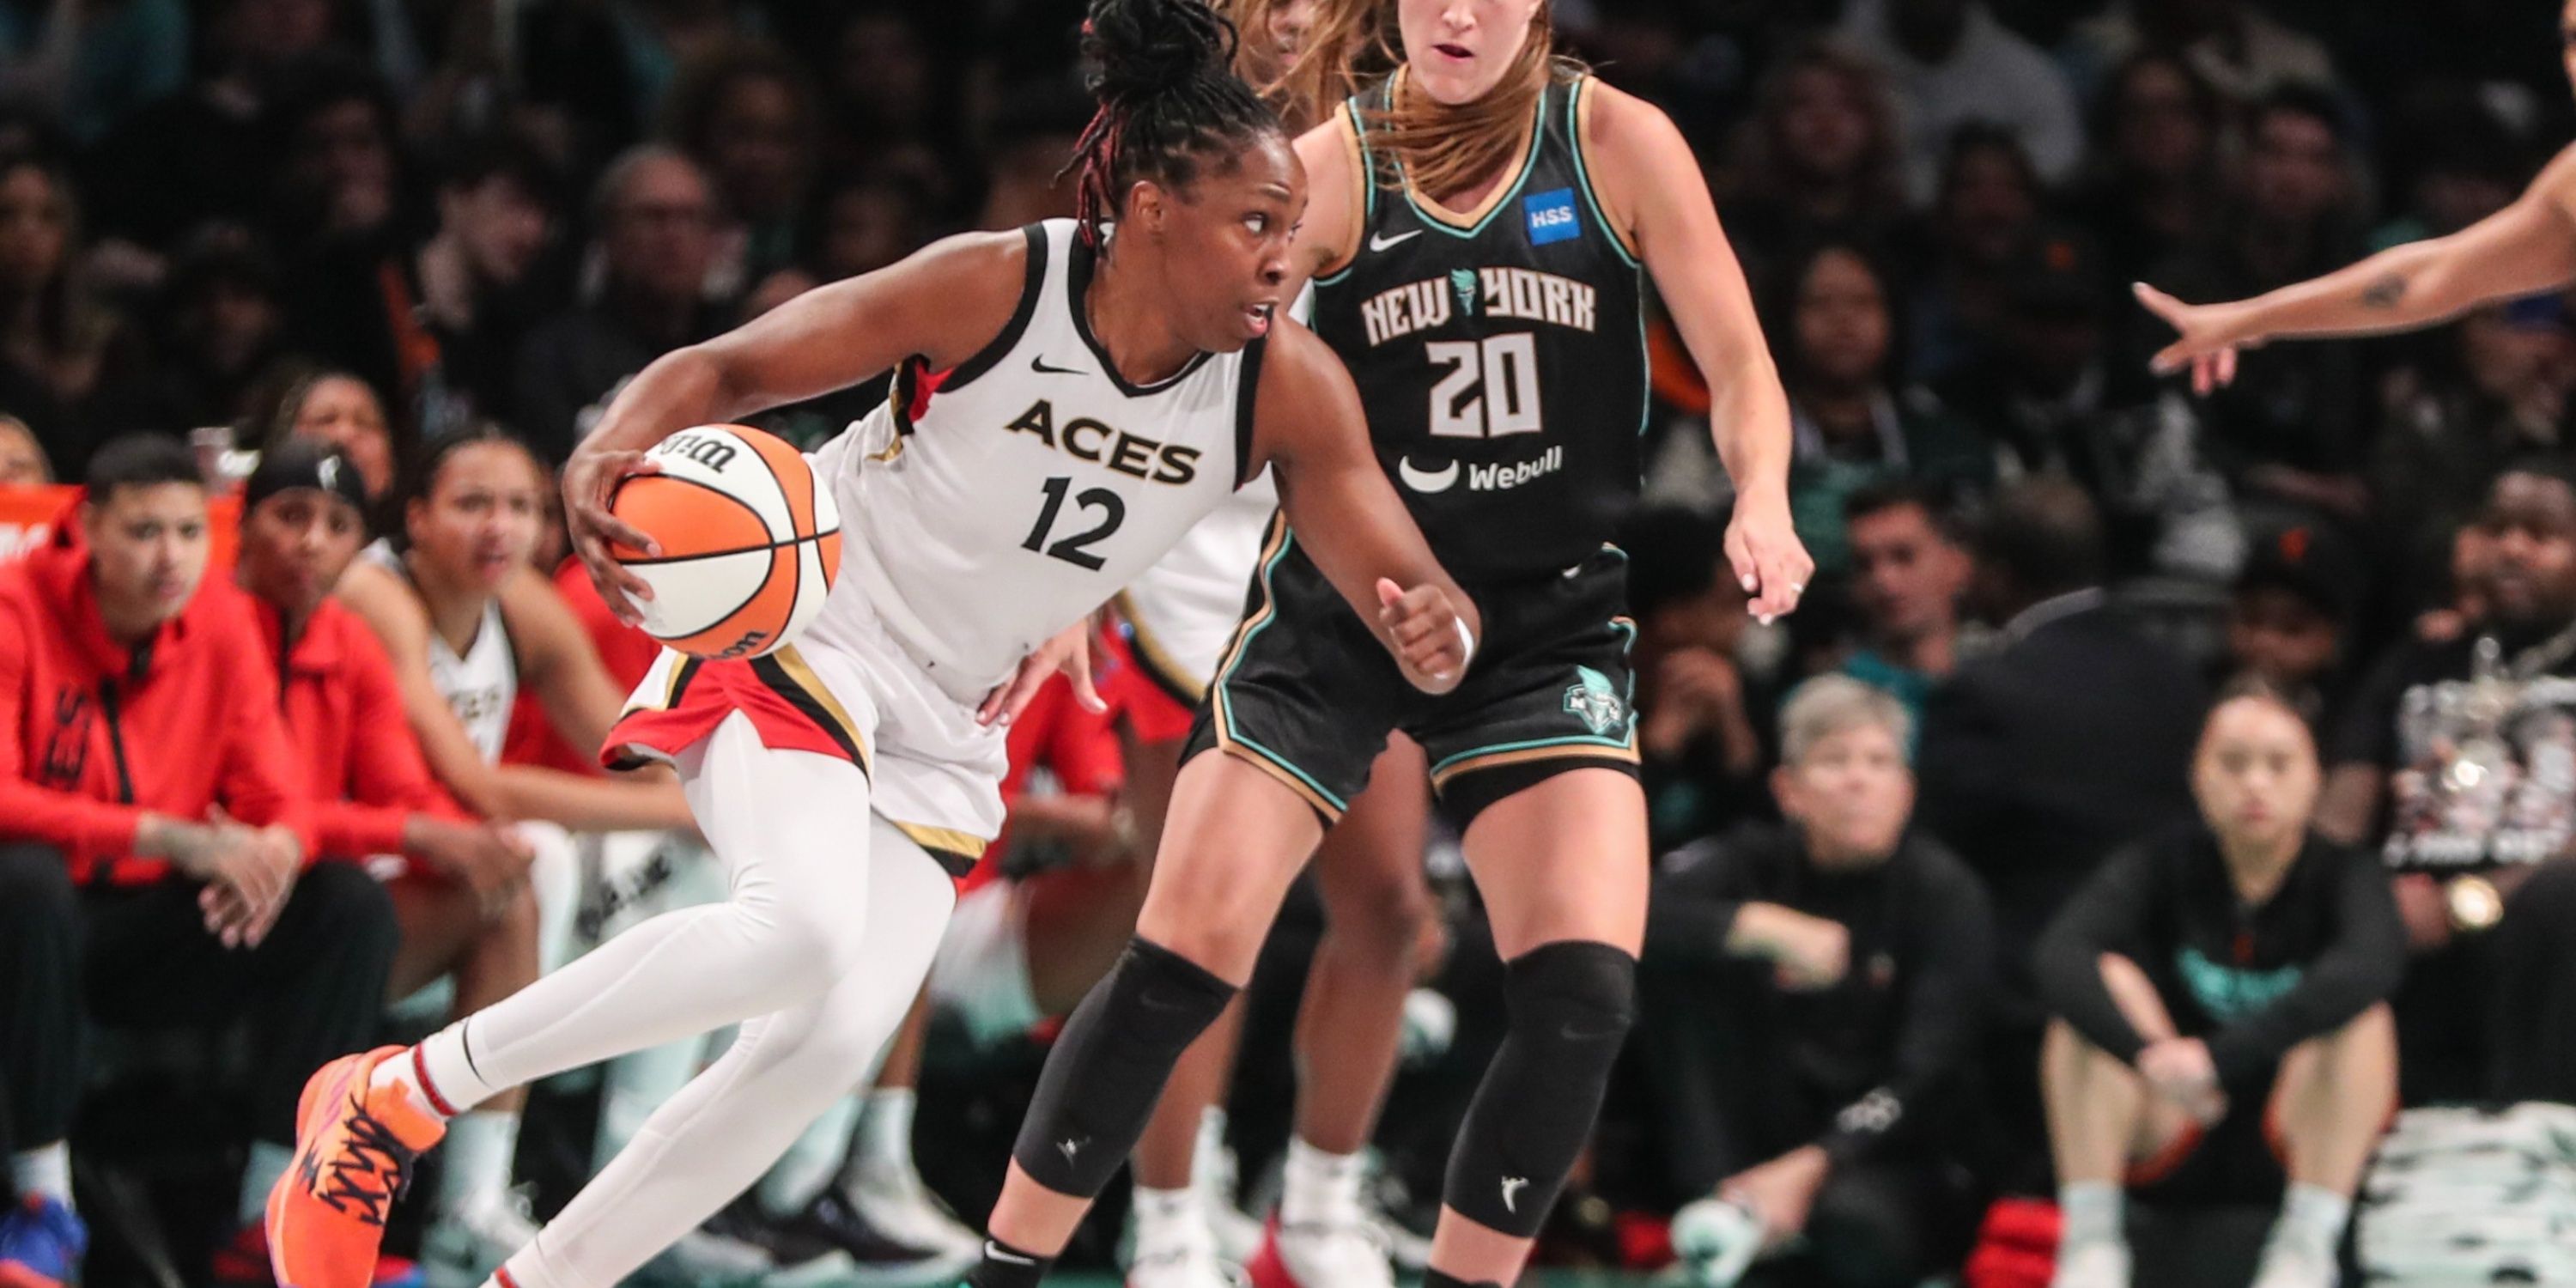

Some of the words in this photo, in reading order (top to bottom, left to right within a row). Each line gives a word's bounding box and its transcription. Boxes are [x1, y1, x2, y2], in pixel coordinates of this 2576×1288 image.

[1531, 206, 1574, 228] HSS
[1360, 276, 1452, 347] NEW
[1479, 267, 1597, 332] YORK
[1425, 332, 1542, 438] 20
[1003, 398, 1203, 486] ACES
[1468, 446, 1563, 491] Webull
[1020, 477, 1126, 572] 12
